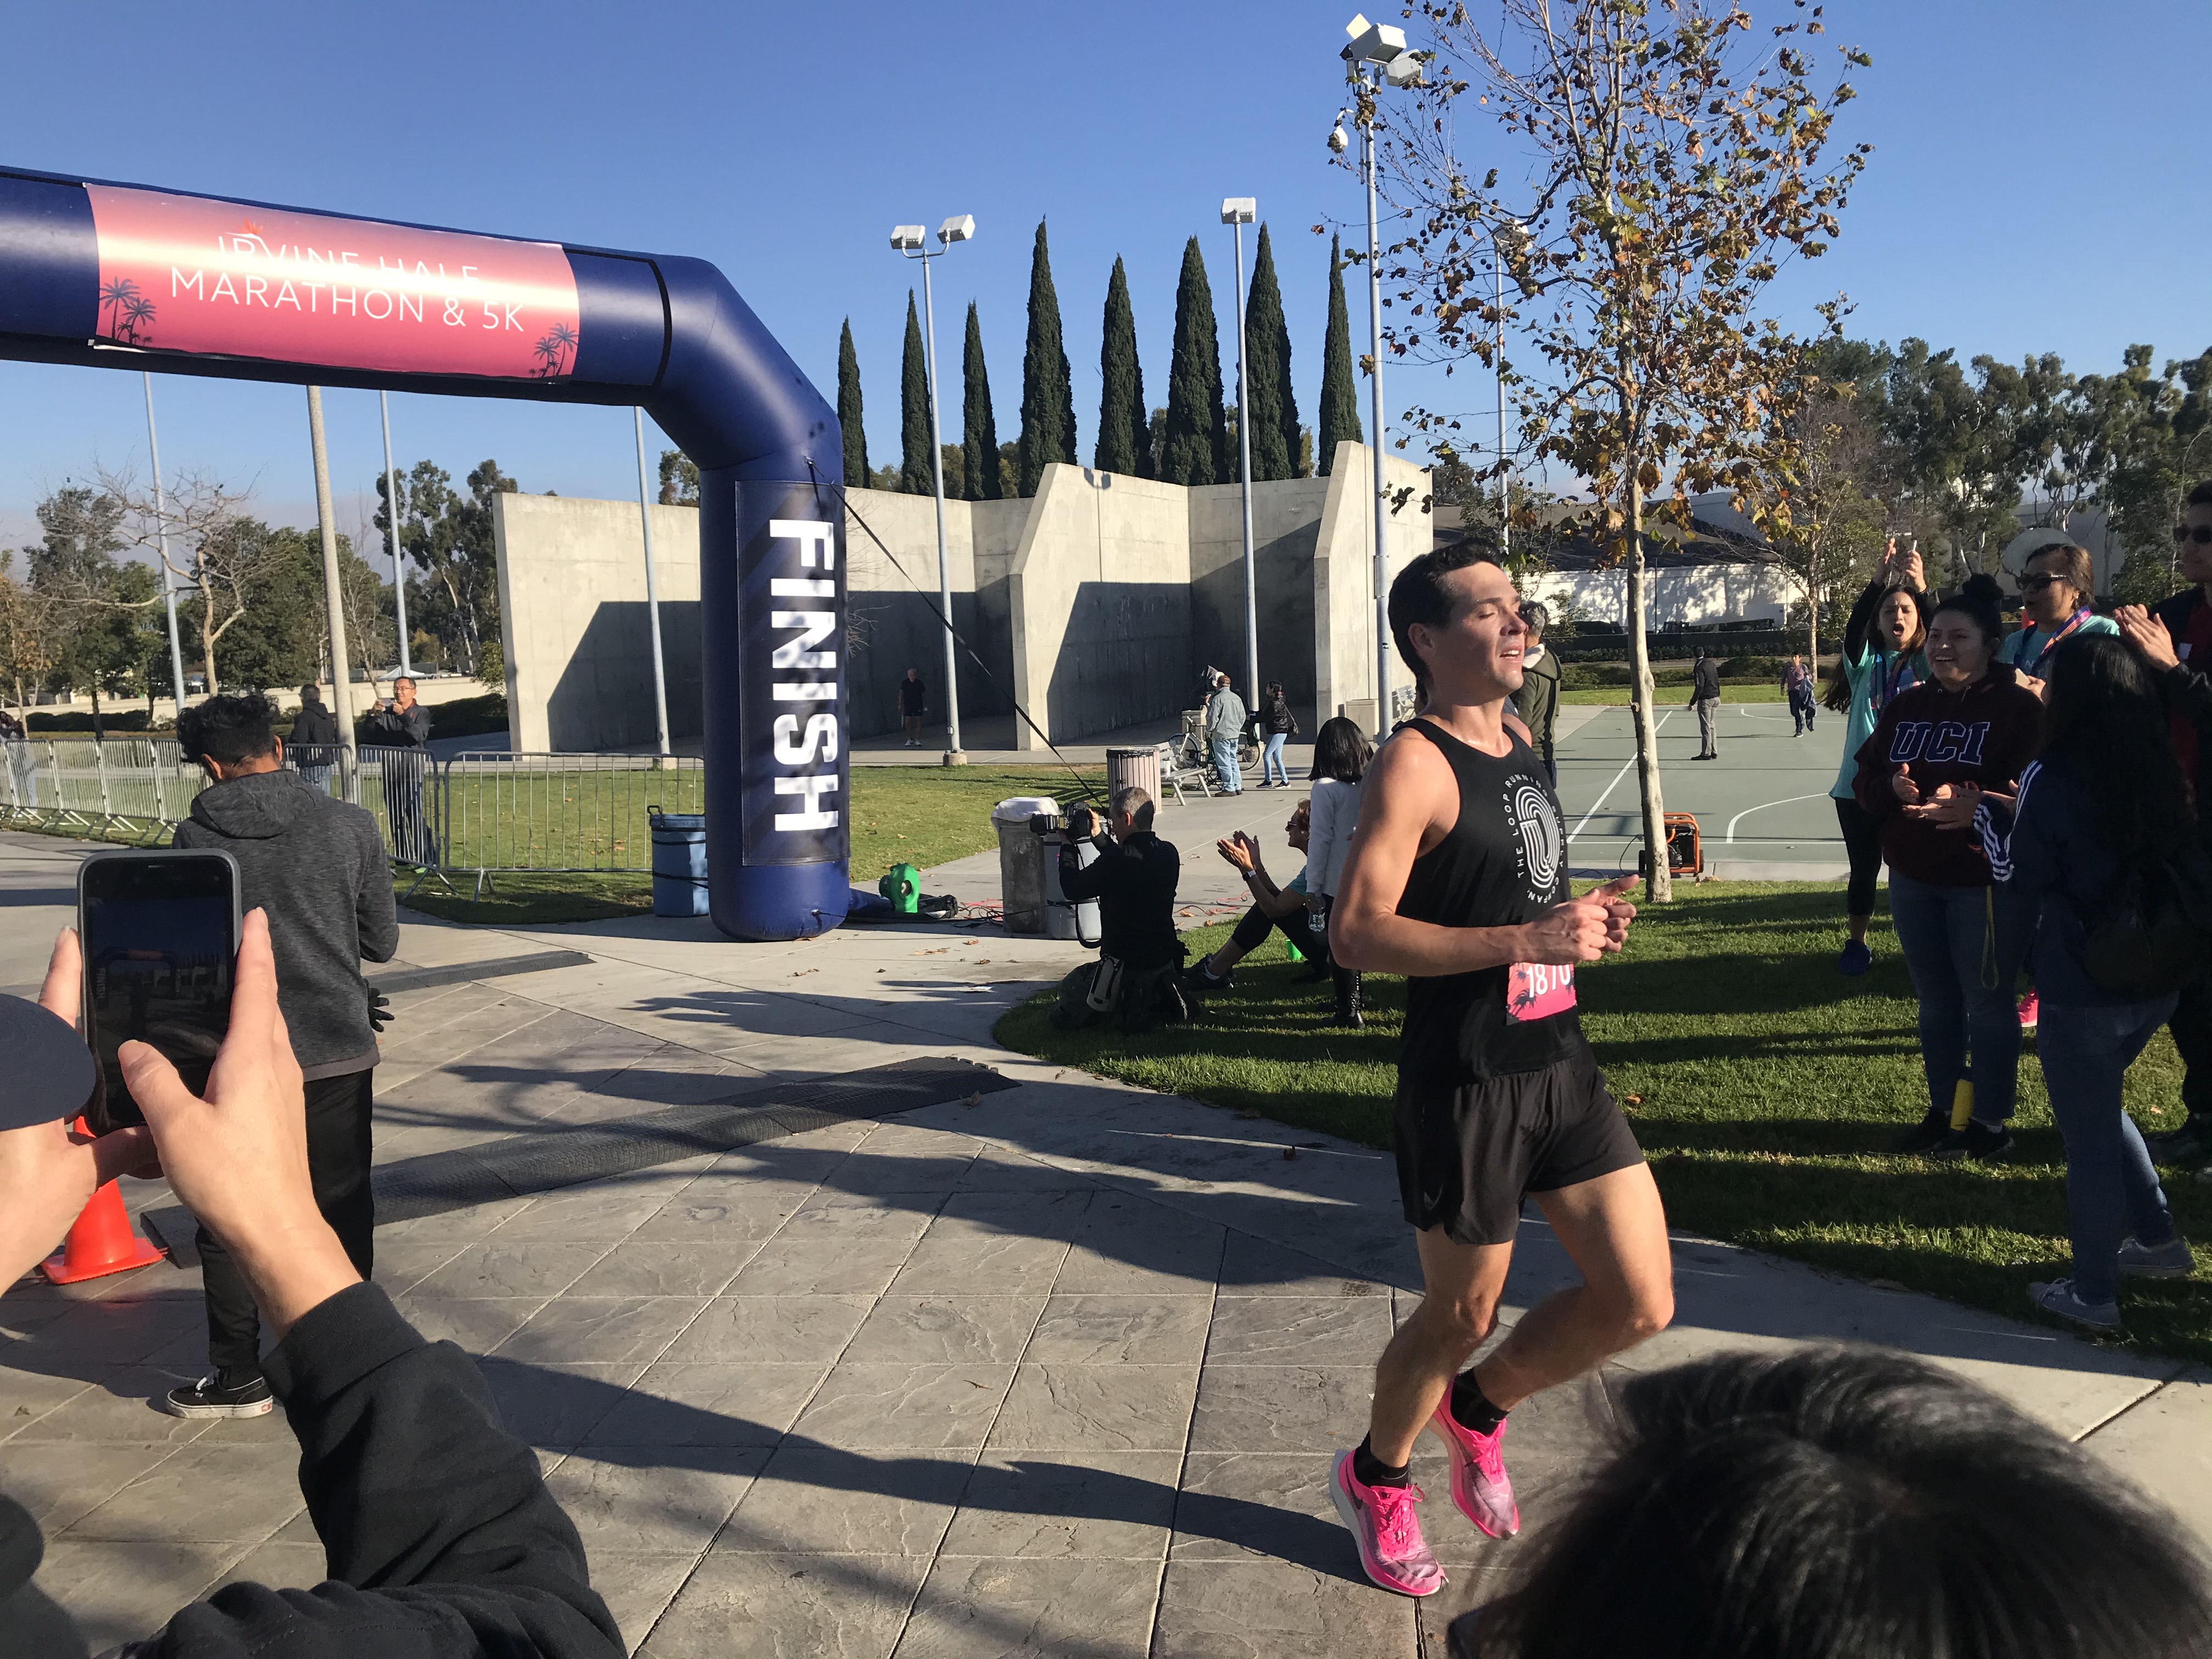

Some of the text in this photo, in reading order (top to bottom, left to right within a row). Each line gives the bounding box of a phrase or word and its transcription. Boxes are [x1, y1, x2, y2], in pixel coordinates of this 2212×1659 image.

[218, 235, 360, 268] IRVINE
[172, 267, 524, 332] MARATHON & 5K
[770, 519, 838, 832] FINISH
[1889, 721, 1991, 766] UCI
[1505, 774, 1548, 797] RUNNING
[1503, 793, 1519, 836] LOOP
[1516, 847, 1525, 878] THE
